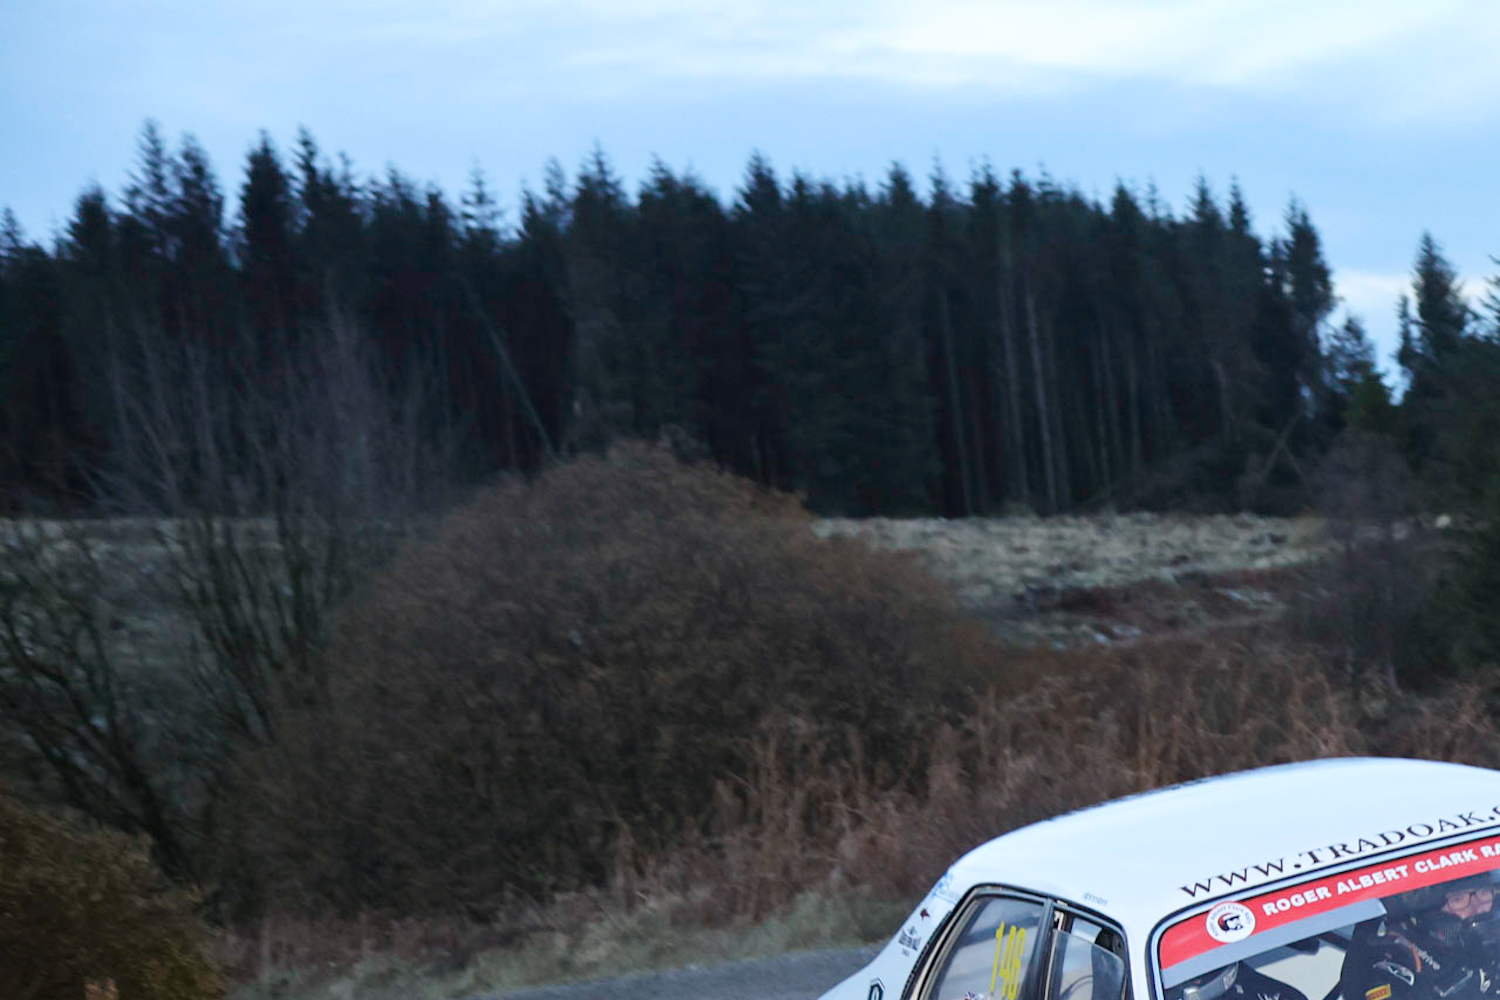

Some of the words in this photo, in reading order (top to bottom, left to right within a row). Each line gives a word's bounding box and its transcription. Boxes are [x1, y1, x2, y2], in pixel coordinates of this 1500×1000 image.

[1262, 886, 1332, 917] ROGER
[1337, 865, 1409, 895] ALBERT
[1414, 849, 1480, 874] CLARK
